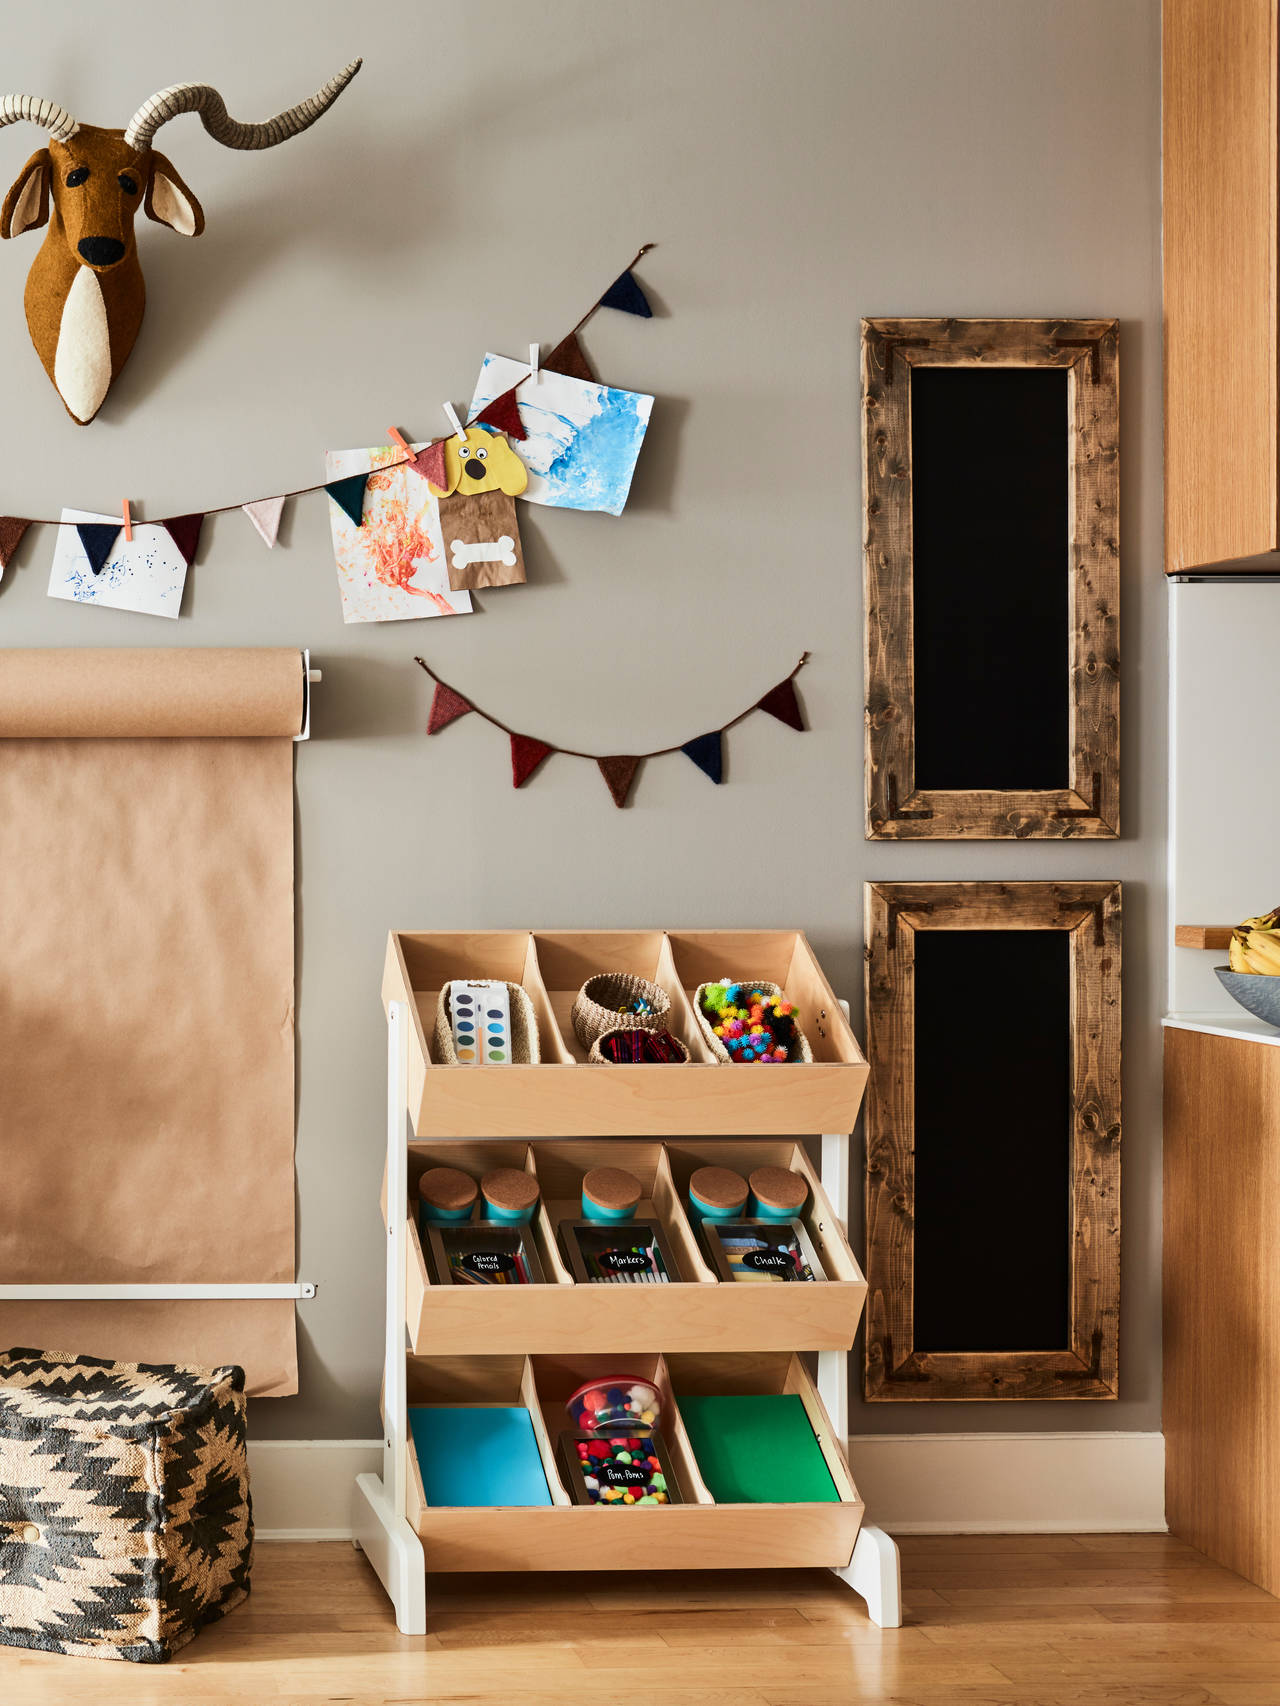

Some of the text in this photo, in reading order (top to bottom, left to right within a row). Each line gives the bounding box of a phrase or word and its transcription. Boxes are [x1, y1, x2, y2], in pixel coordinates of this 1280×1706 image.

[472, 1255, 498, 1263] Colored
[609, 1255, 645, 1268] Markers
[754, 1255, 787, 1266] Chalk
[477, 1262, 500, 1270] Pencils
[606, 1469, 644, 1481] Pom-Poms
